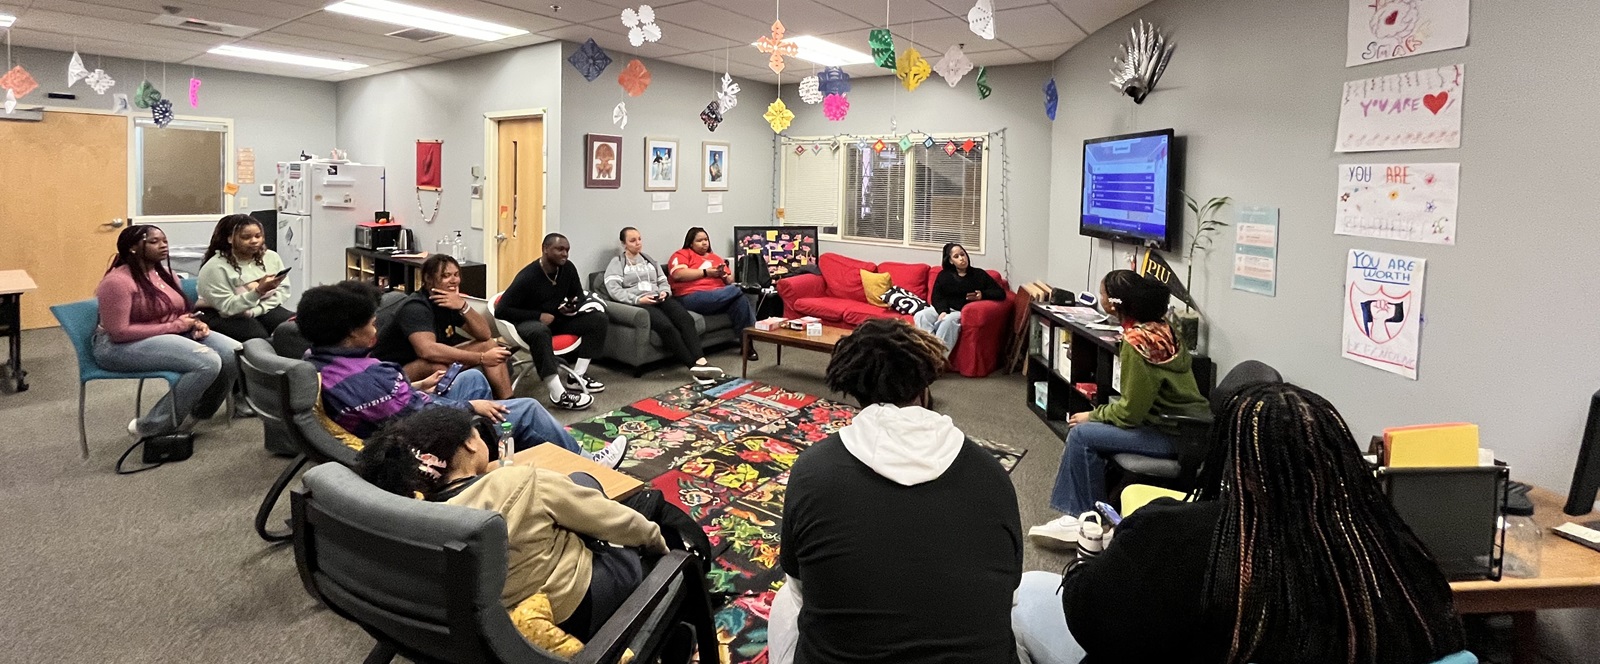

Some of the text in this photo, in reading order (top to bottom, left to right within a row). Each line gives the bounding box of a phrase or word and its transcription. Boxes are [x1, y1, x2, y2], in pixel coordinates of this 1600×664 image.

[1360, 97, 1420, 117] YOU ARE
[1348, 165, 1411, 184] YOU ARE
[1353, 250, 1416, 272] YOU ARE
[1363, 269, 1411, 281] WORTH
